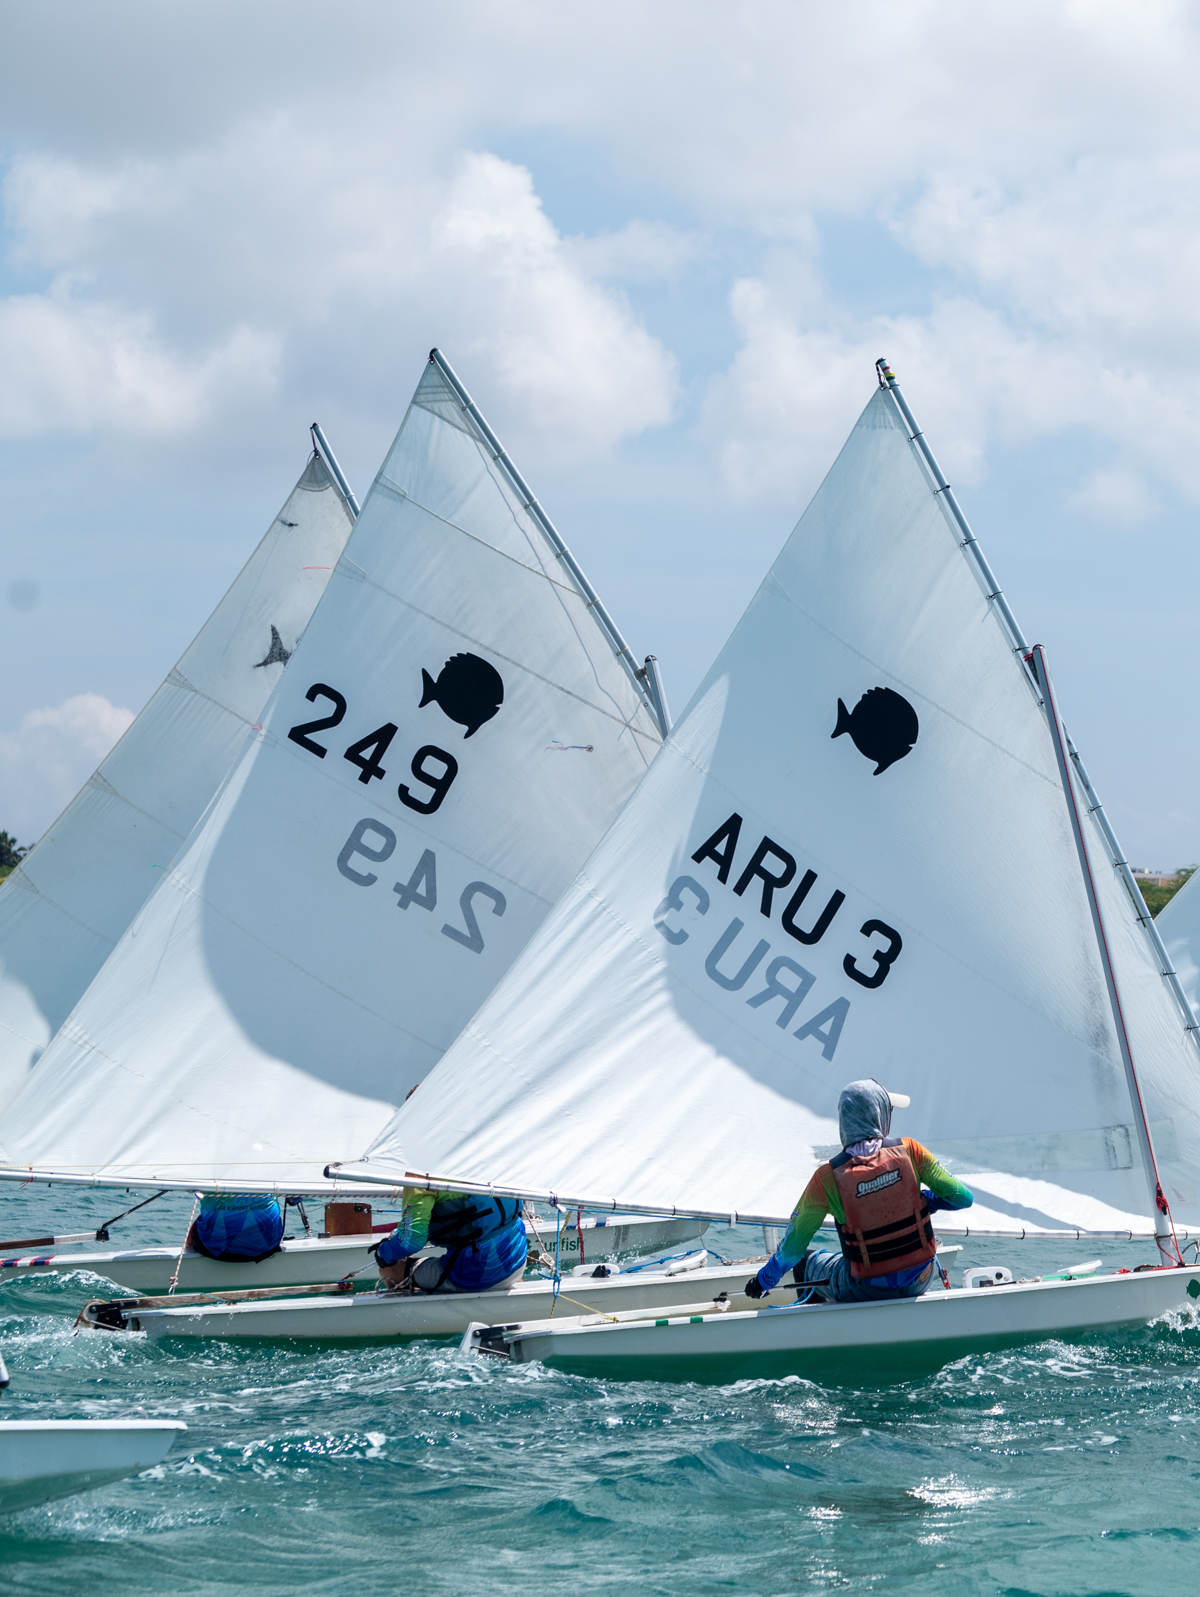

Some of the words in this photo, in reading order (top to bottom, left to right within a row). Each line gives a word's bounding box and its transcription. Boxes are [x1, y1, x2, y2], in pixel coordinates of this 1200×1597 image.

[287, 683, 459, 815] 249
[690, 812, 847, 945] ARU
[842, 918, 903, 989] 3
[857, 1168, 900, 1194] Qualifier
